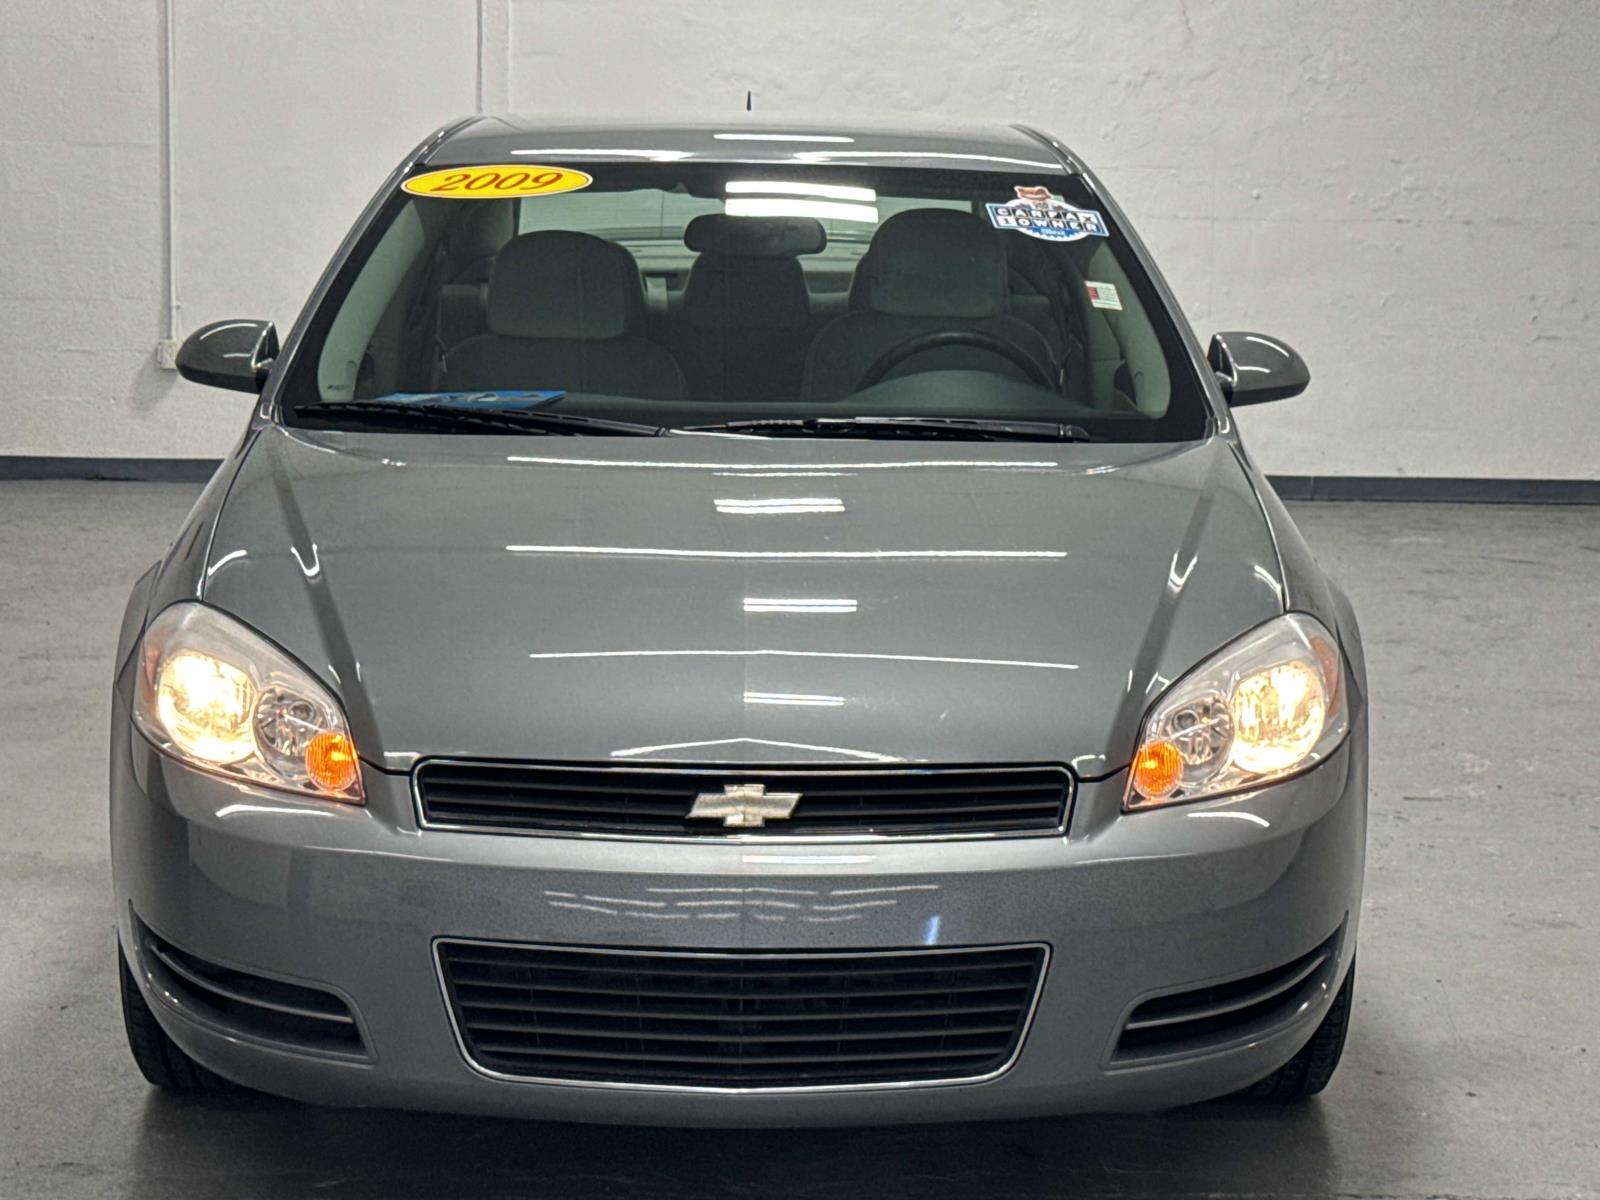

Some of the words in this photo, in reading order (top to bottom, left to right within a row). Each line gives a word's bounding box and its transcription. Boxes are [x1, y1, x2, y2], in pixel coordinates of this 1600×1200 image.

[430, 172, 564, 192] 2009
[997, 208, 1096, 222] CARFAX
[1017, 219, 1097, 232] OWNER
